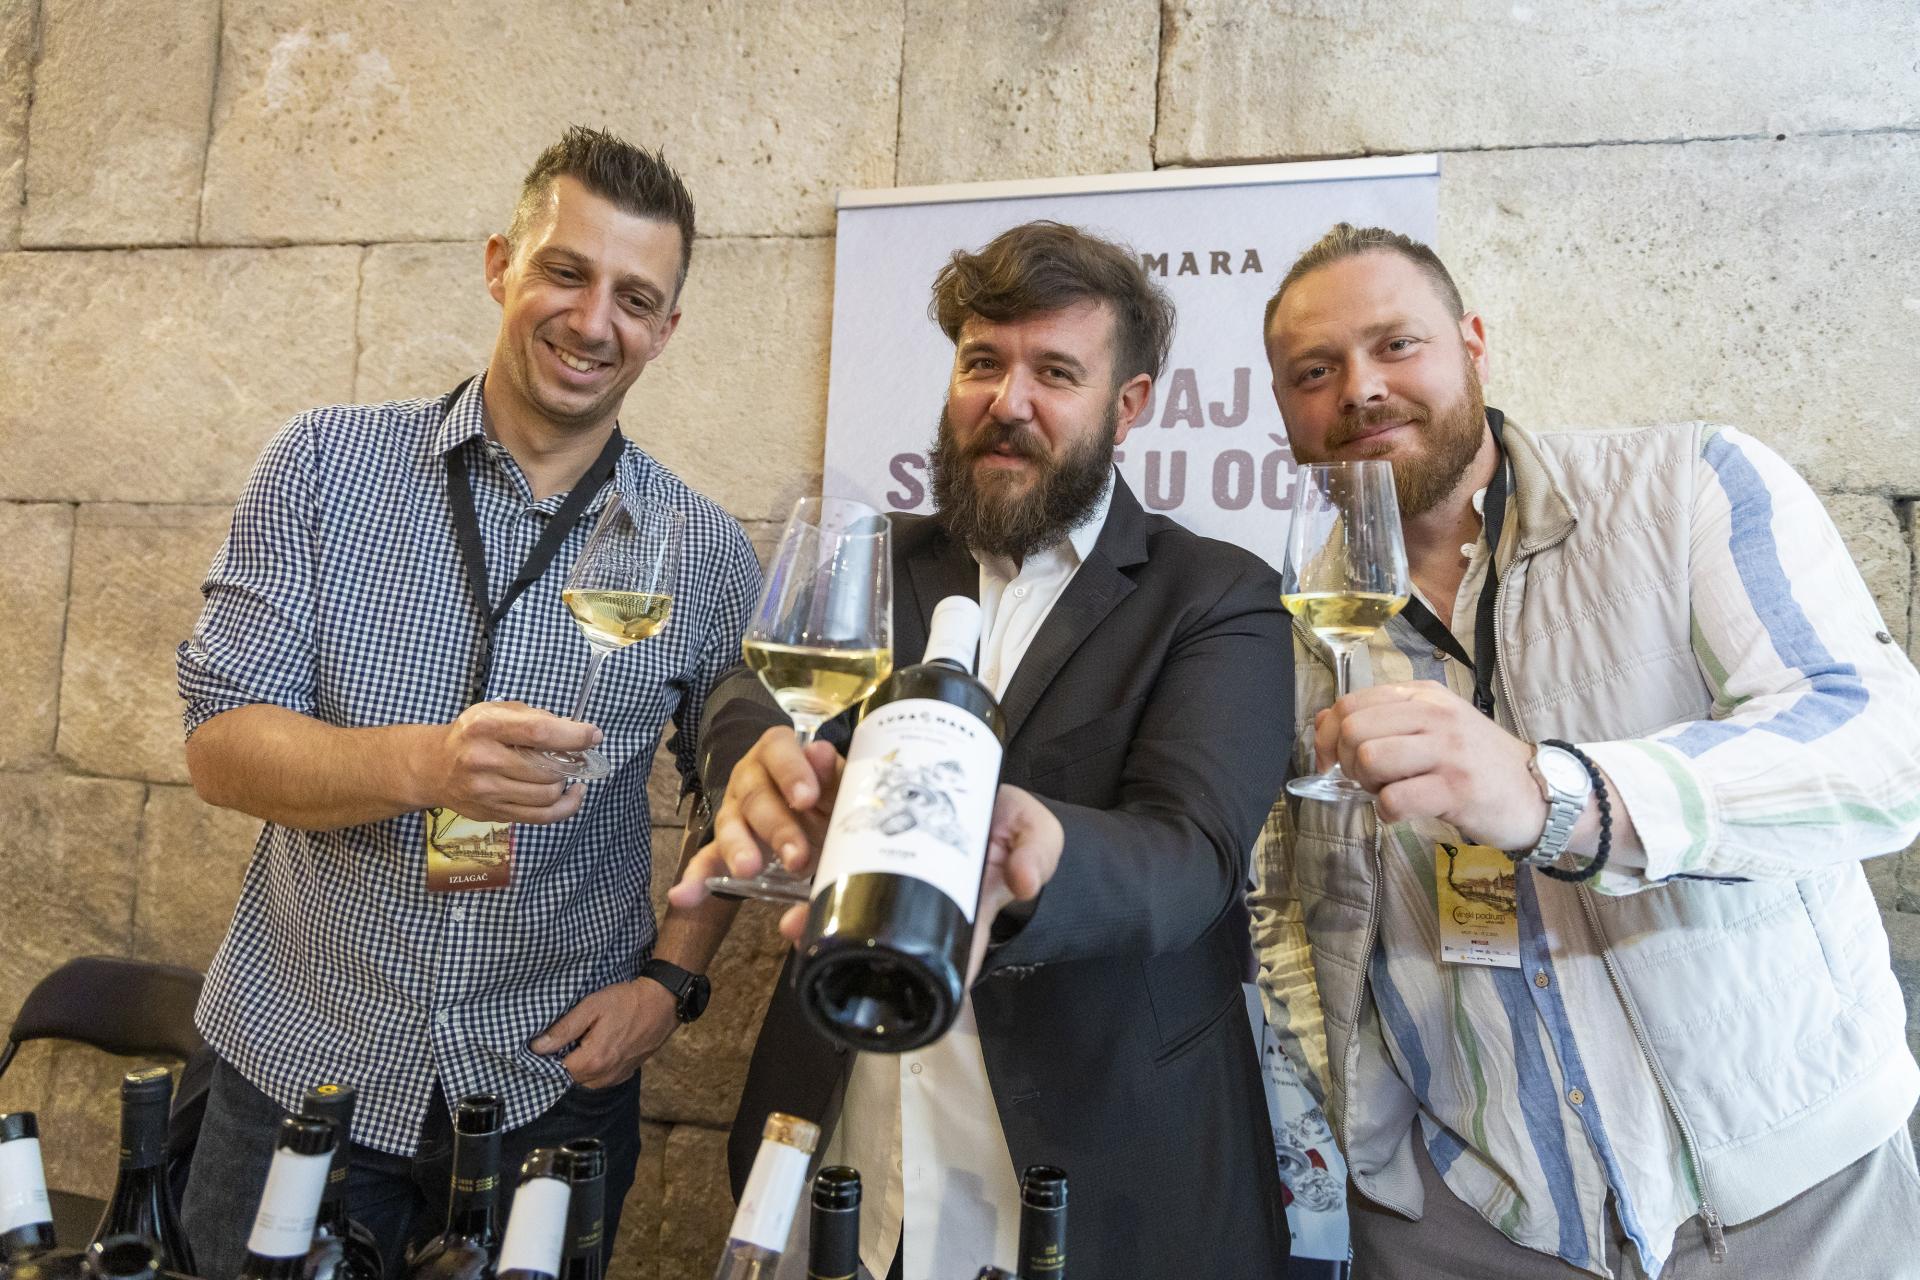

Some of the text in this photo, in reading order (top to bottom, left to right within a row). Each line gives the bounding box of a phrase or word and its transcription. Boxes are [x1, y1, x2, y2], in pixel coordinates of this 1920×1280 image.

[1141, 249, 1263, 277] MARA
[1144, 450, 1187, 511] U
[449, 872, 488, 884] IZLAGAČ
